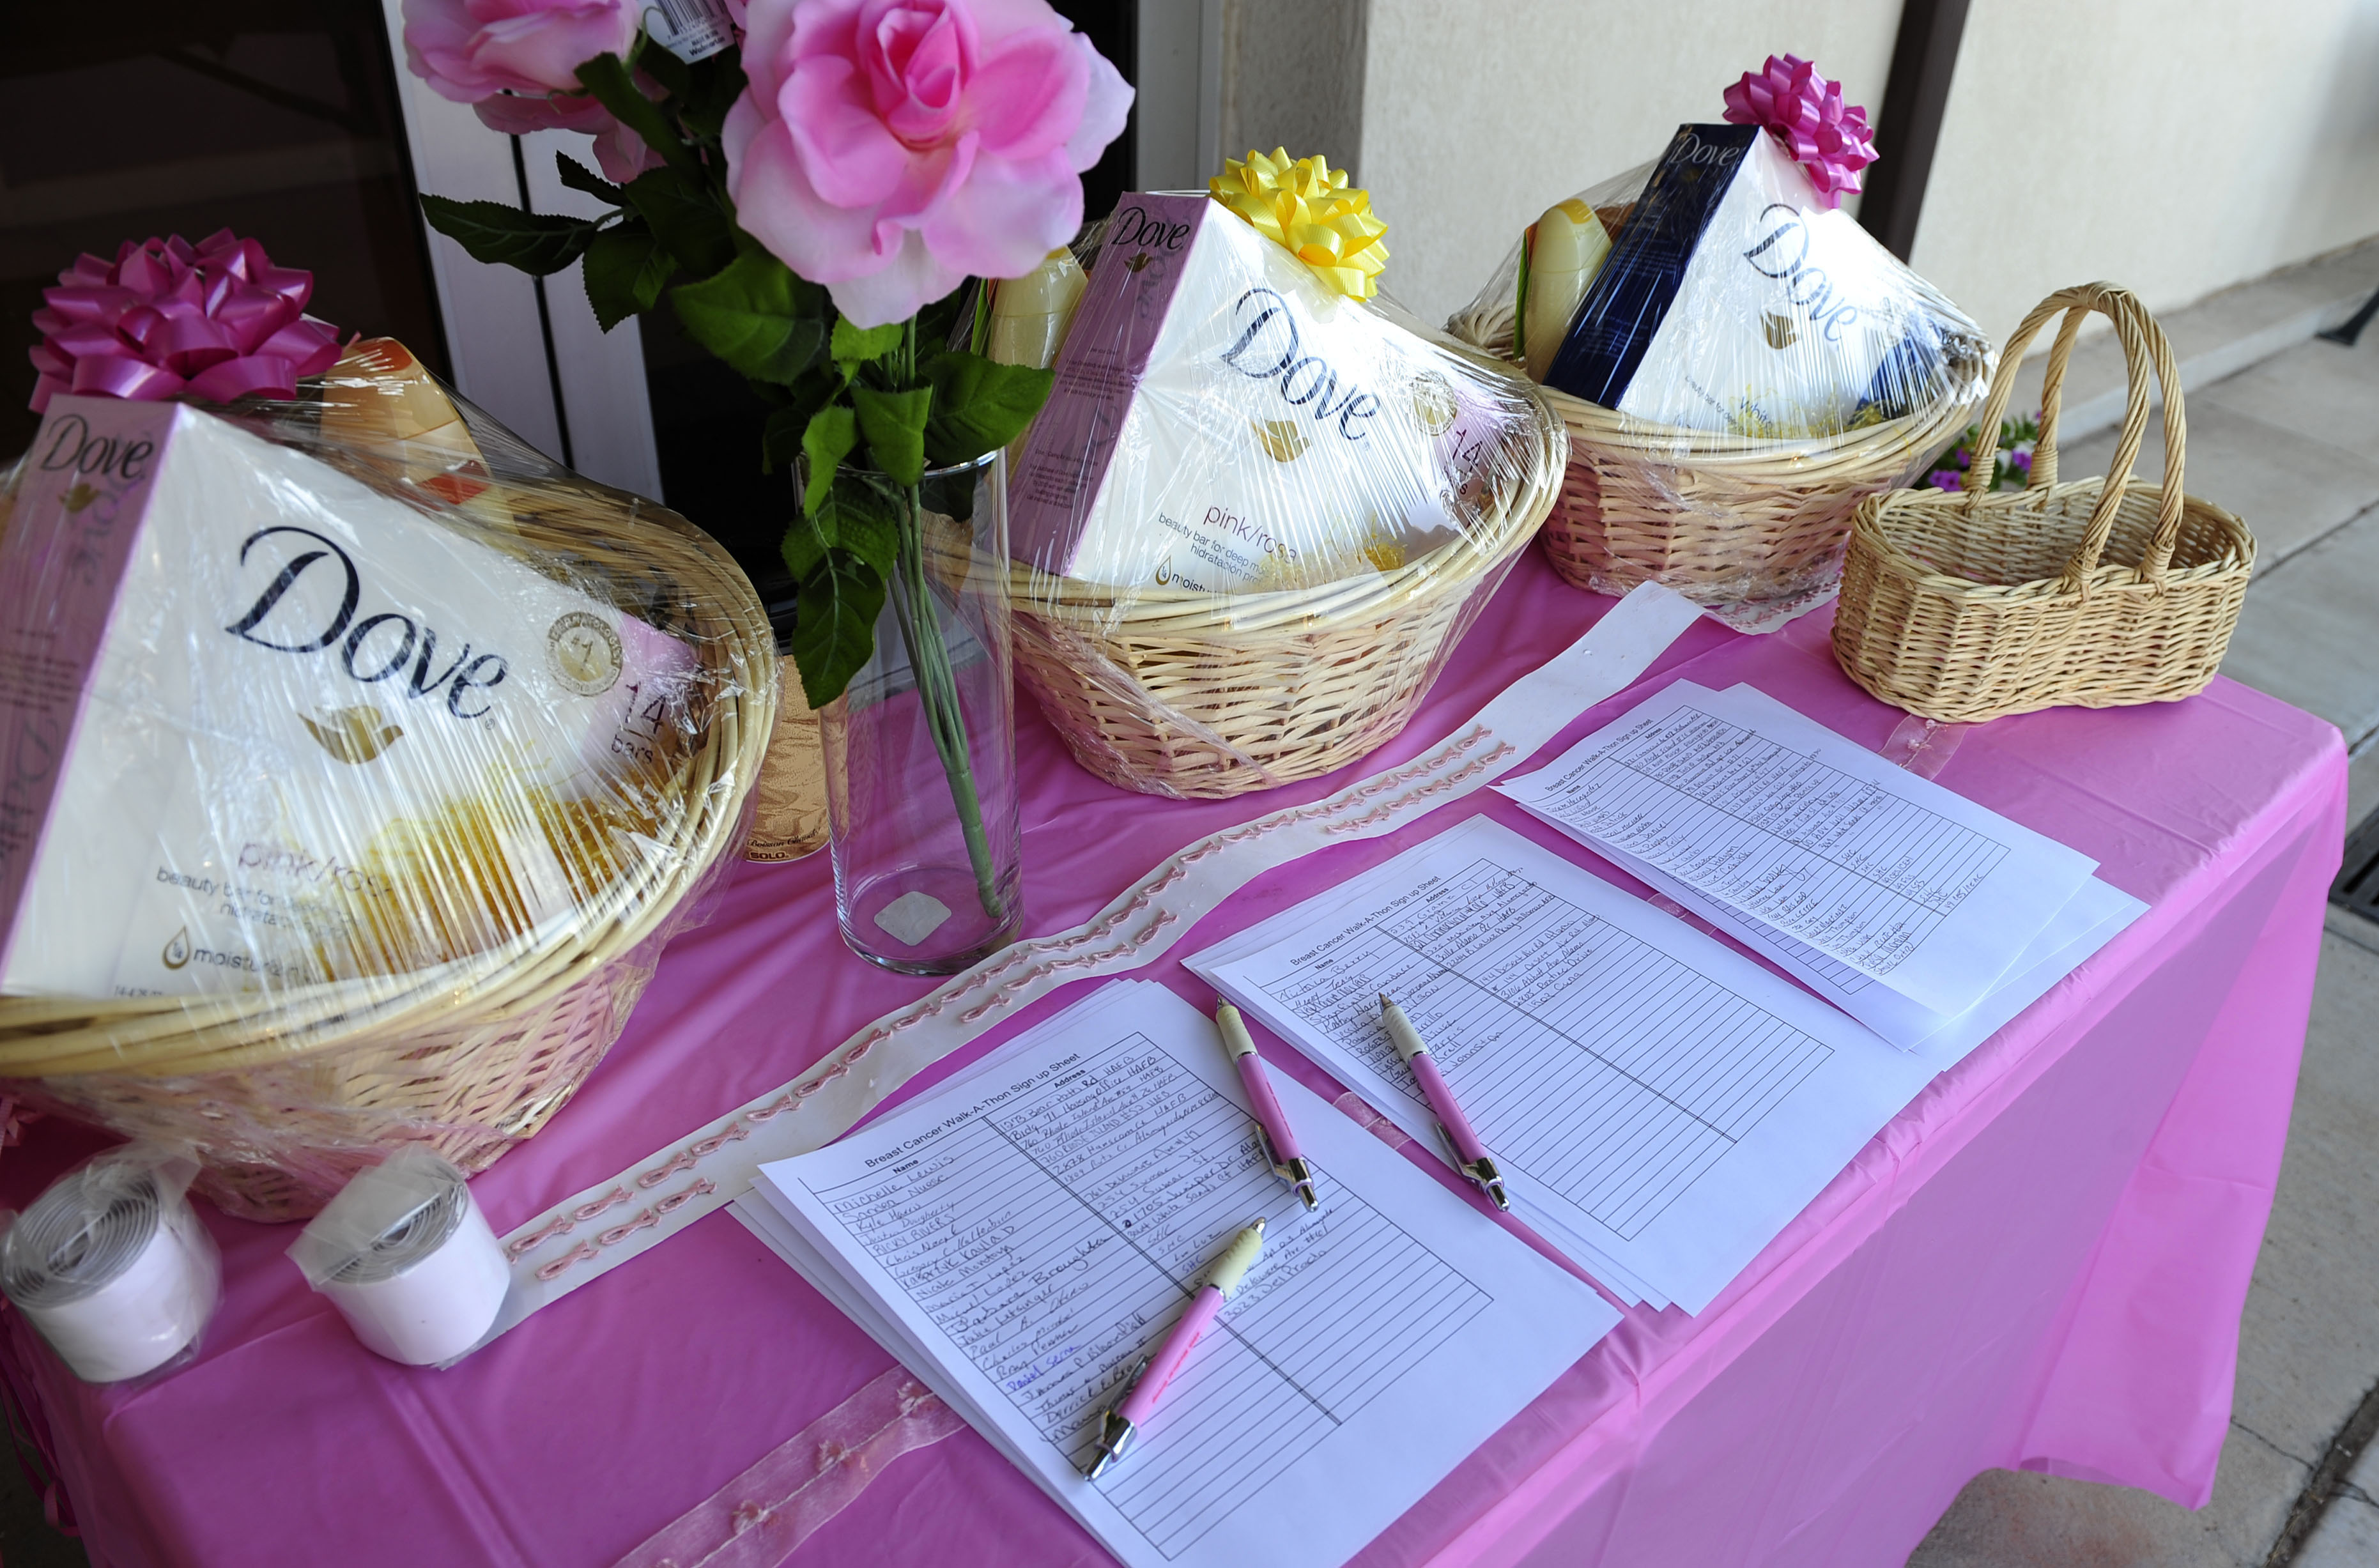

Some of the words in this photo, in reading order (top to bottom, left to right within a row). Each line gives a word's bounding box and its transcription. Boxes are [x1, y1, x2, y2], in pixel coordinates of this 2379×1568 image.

[1669, 133, 1740, 166] Dove
[1111, 206, 1190, 250] Dove
[1743, 202, 1858, 342] Dove
[1220, 287, 1381, 442] Dove
[40, 413, 153, 479] Dove
[1159, 512, 1192, 539] beauty
[1193, 530, 1210, 546] bar
[1226, 548, 1249, 567] deep
[1203, 505, 1298, 564] pink/rosa
[224, 525, 509, 719] Dove
[626, 680, 666, 734] 14
[612, 733, 655, 765] bars
[1544, 778, 1567, 792] Breast
[1561, 764, 1585, 780] Cancer
[1615, 733, 1632, 742] Sign
[1424, 888, 1449, 903] Address
[1289, 949, 1319, 965] Breast
[1314, 933, 1347, 951] Cancer
[1342, 905, 1394, 935] Walk-A-Thon
[1389, 895, 1411, 907] Sign
[1416, 875, 1442, 890] Sheet
[1314, 958, 1334, 969] Name
[1328, 950, 1379, 976] Berry
[1052, 1069, 1086, 1088] Address
[1080, 1075, 1099, 1087] Rd
[864, 1146, 904, 1167] Breast
[901, 1125, 945, 1149] Cancer
[941, 1090, 1012, 1128] Walk-A-Thon
[1009, 1077, 1038, 1093] Sign
[1035, 1070, 1052, 1080] up
[1047, 1052, 1082, 1071] Sheet
[1151, 1093, 1189, 1117] HAFB
[891, 1158, 920, 1174] Name
[833, 1178, 903, 1215] Michelle
[905, 1154, 955, 1182] Lewis
[1130, 1195, 1167, 1220] 1705
[1160, 1169, 1217, 1202] Juniper
[908, 1213, 955, 1240] RIVERS
[959, 1233, 1002, 1261] Kayla
[1002, 1224, 1017, 1235] D
[1143, 1224, 1176, 1247] SHC
[1157, 1234, 1185, 1254] SHC
[1180, 1254, 1206, 1273] SHC
[1224, 1292, 1261, 1320] 3023
[966, 1333, 1004, 1360] Paul
